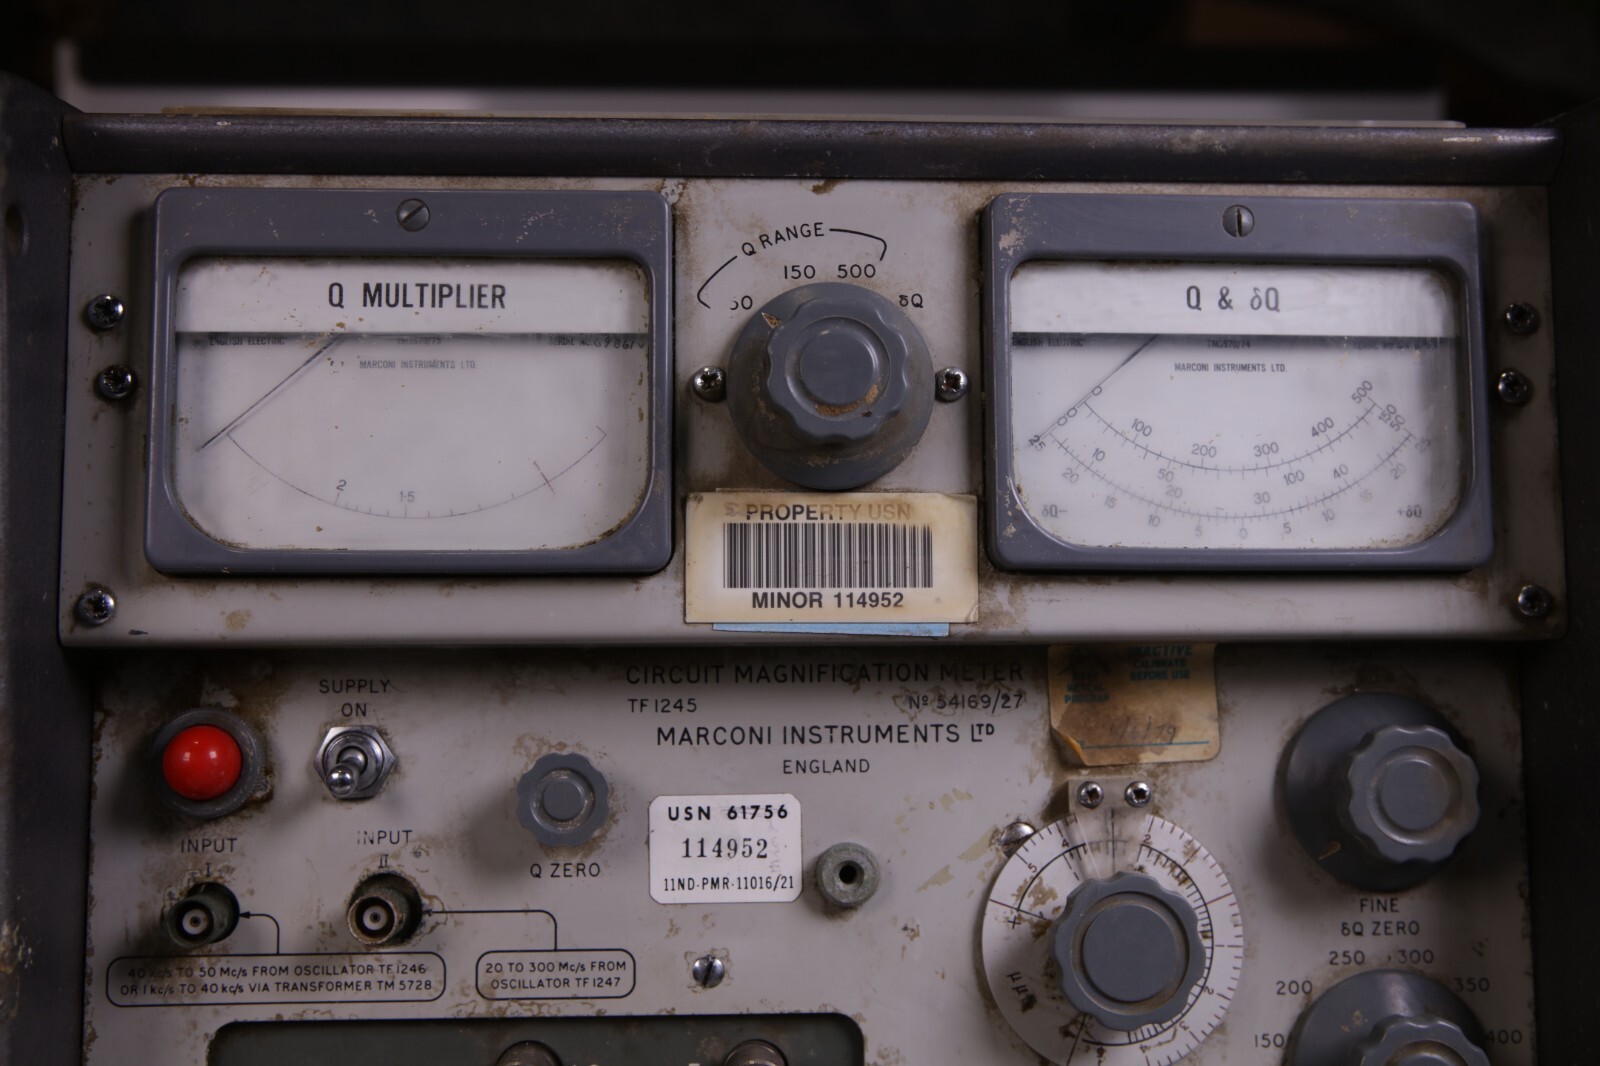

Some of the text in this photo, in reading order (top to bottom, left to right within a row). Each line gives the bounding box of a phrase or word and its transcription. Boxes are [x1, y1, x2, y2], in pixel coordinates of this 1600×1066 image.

[741, 222, 825, 256] Q RANGE
[783, 263, 876, 279] 150 500
[327, 282, 506, 309] Q MULTIPLIER
[1186, 285, 1202, 311] Q
[1218, 286, 1234, 310] &
[360, 360, 396, 369] MARCONI
[401, 360, 456, 369] INSTRUMENTS
[1174, 362, 1209, 373] MARCONI
[1213, 362, 1267, 373] INSTRUMENTS
[1131, 418, 1153, 437] 100
[1191, 443, 1217, 458] 200
[1253, 441, 1279, 458] 300
[1311, 417, 1335, 438] 400
[1351, 380, 1374, 404] 500
[1092, 448, 1106, 462] 10
[1165, 484, 1183, 499] 20
[1254, 491, 1271, 505] 30
[1332, 464, 1349, 480] 40
[1157, 468, 1175, 483] 50
[1283, 470, 1305, 486] 100
[335, 479, 347, 492] 2
[1062, 467, 1080, 484] 20
[1104, 496, 1118, 509] 15
[1148, 514, 1161, 528] 10
[1283, 522, 1292, 534] 5
[1322, 508, 1336, 522] 10
[746, 503, 911, 521] PROPERTY USN
[752, 592, 904, 609] MINOR 114952
[626, 662, 1024, 684] CIRCUIT MAGNIFICATION METER
[319, 679, 391, 694] SUPPLY
[341, 703, 367, 718] ON
[657, 726, 772, 746] MARCONI
[783, 724, 960, 745] INSTRUMENTS
[783, 758, 870, 774] ENGLAND
[668, 804, 788, 821] USN 61756
[357, 829, 413, 845] INPUT
[1143, 833, 1152, 845] 2
[181, 838, 238, 853] INPUT
[682, 837, 768, 859] 114952
[530, 863, 600, 879] Q ZERO
[1028, 862, 1038, 873] 5
[1360, 898, 1400, 913] FINE
[1372, 920, 1420, 936] ZERO
[1329, 949, 1435, 966] 250 300
[128, 967, 145, 978] 40
[177, 967, 194, 978] TO
[199, 967, 216, 978] 50
[220, 966, 248, 979] Mc/s
[252, 965, 289, 977] FROM
[294, 964, 375, 976] OSCILLATOR
[485, 961, 626, 974] 20 TO 300 Mc/s FROM
[120, 984, 138, 996] OR
[179, 983, 196, 994] TO
[201, 983, 218, 994] 40
[249, 982, 270, 993] VIA
[275, 981, 372, 992] TRANSFORMER
[491, 977, 571, 990] OSCILLATOR
[1276, 980, 1313, 996] 200
[1455, 977, 1490, 993] 350
[1254, 1033, 1285, 1049] 150
[1486, 1029, 1522, 1045] 400
